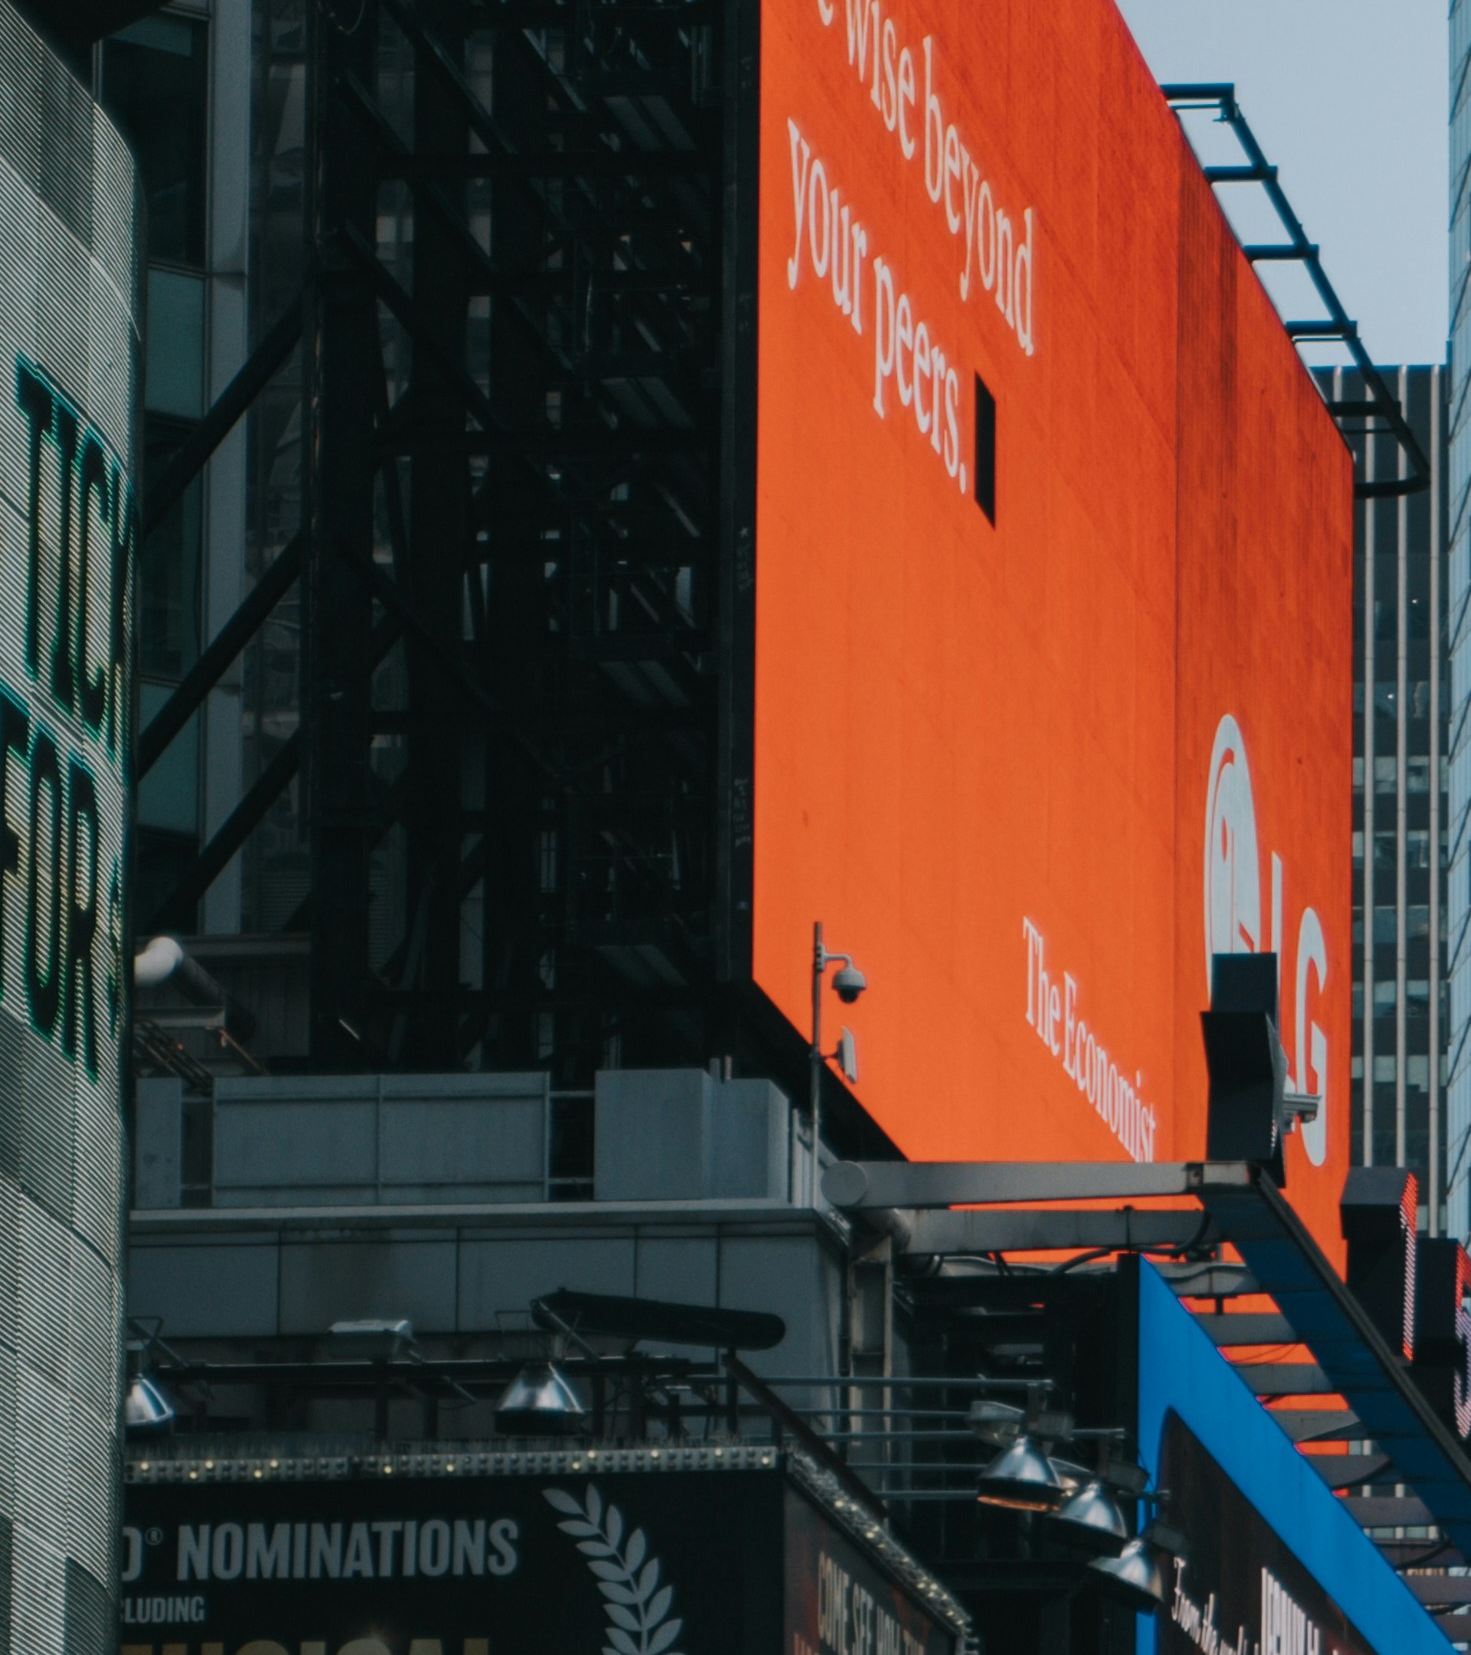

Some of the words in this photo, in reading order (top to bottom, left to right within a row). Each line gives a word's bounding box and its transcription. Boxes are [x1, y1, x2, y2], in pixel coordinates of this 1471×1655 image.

[786, 116, 868, 336] your
[872, 259, 968, 495] peers.
[922, 34, 1035, 356] beyond
[1021, 914, 1061, 1060] The
[1061, 969, 1158, 1164] Economist
[175, 1518, 520, 1582] NOMINATIONS
